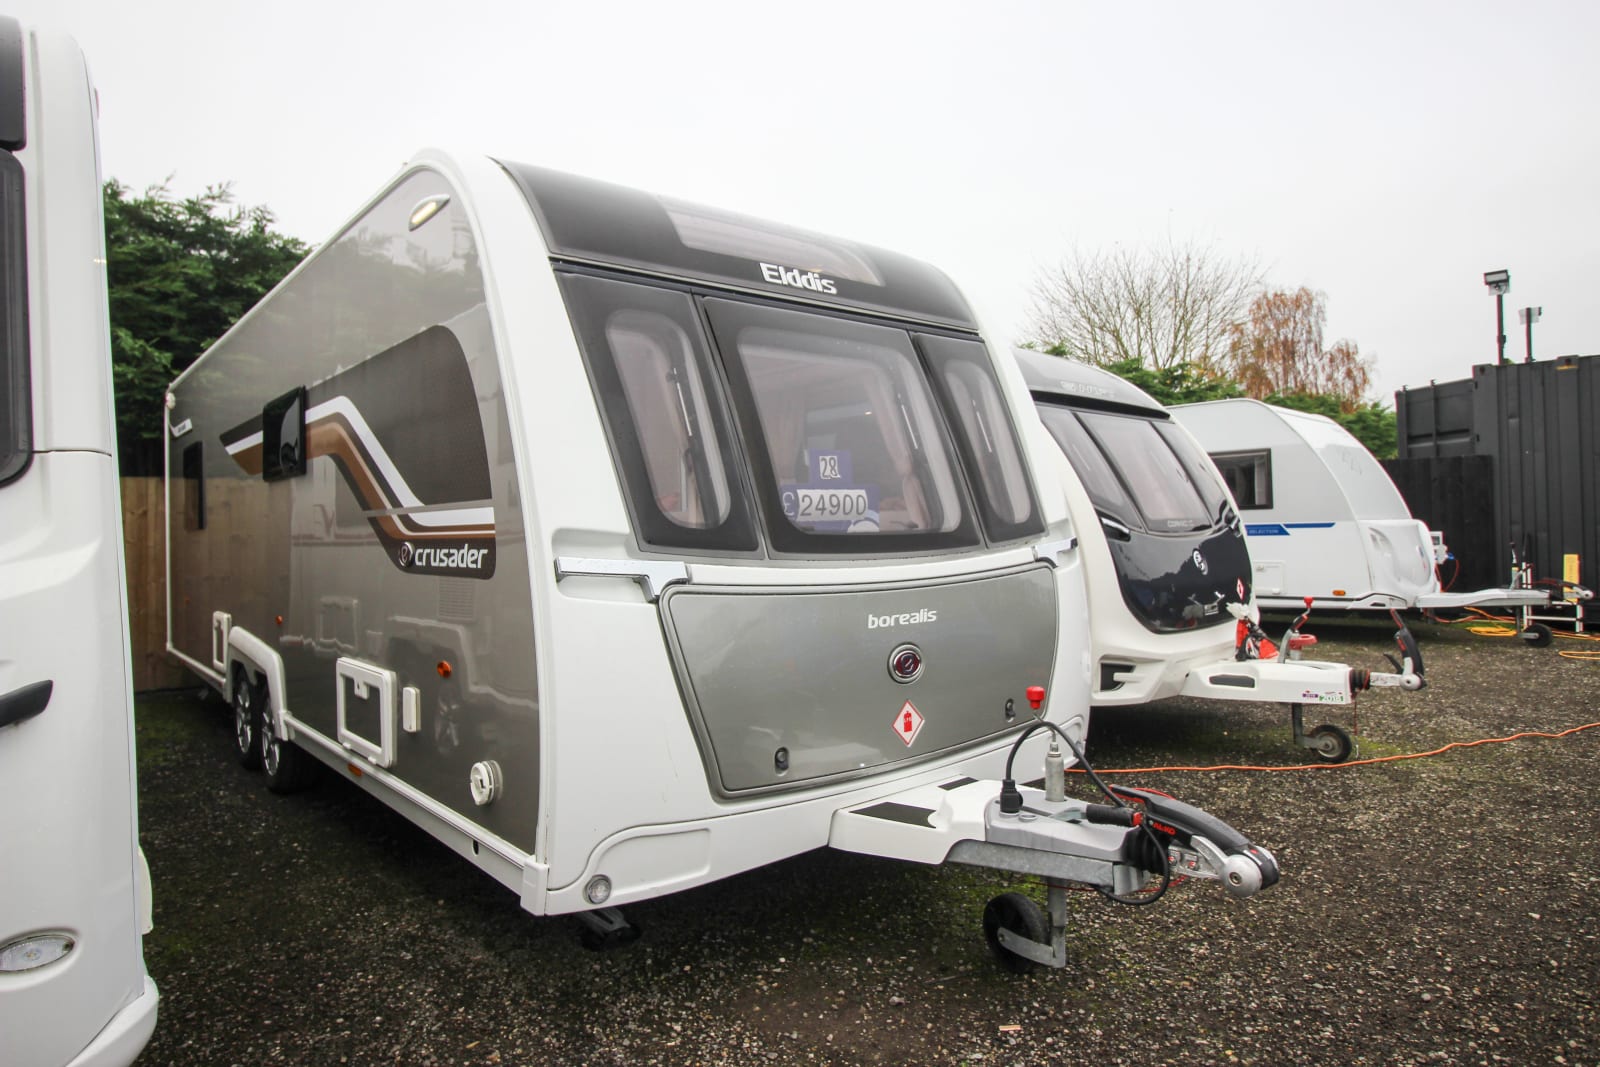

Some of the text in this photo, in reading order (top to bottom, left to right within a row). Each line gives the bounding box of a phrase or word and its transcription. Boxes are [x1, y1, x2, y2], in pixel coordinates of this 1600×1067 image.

[759, 262, 837, 295] Elddis
[820, 456, 838, 477] 28
[414, 543, 489, 569] crusader
[867, 608, 937, 629] borealis
